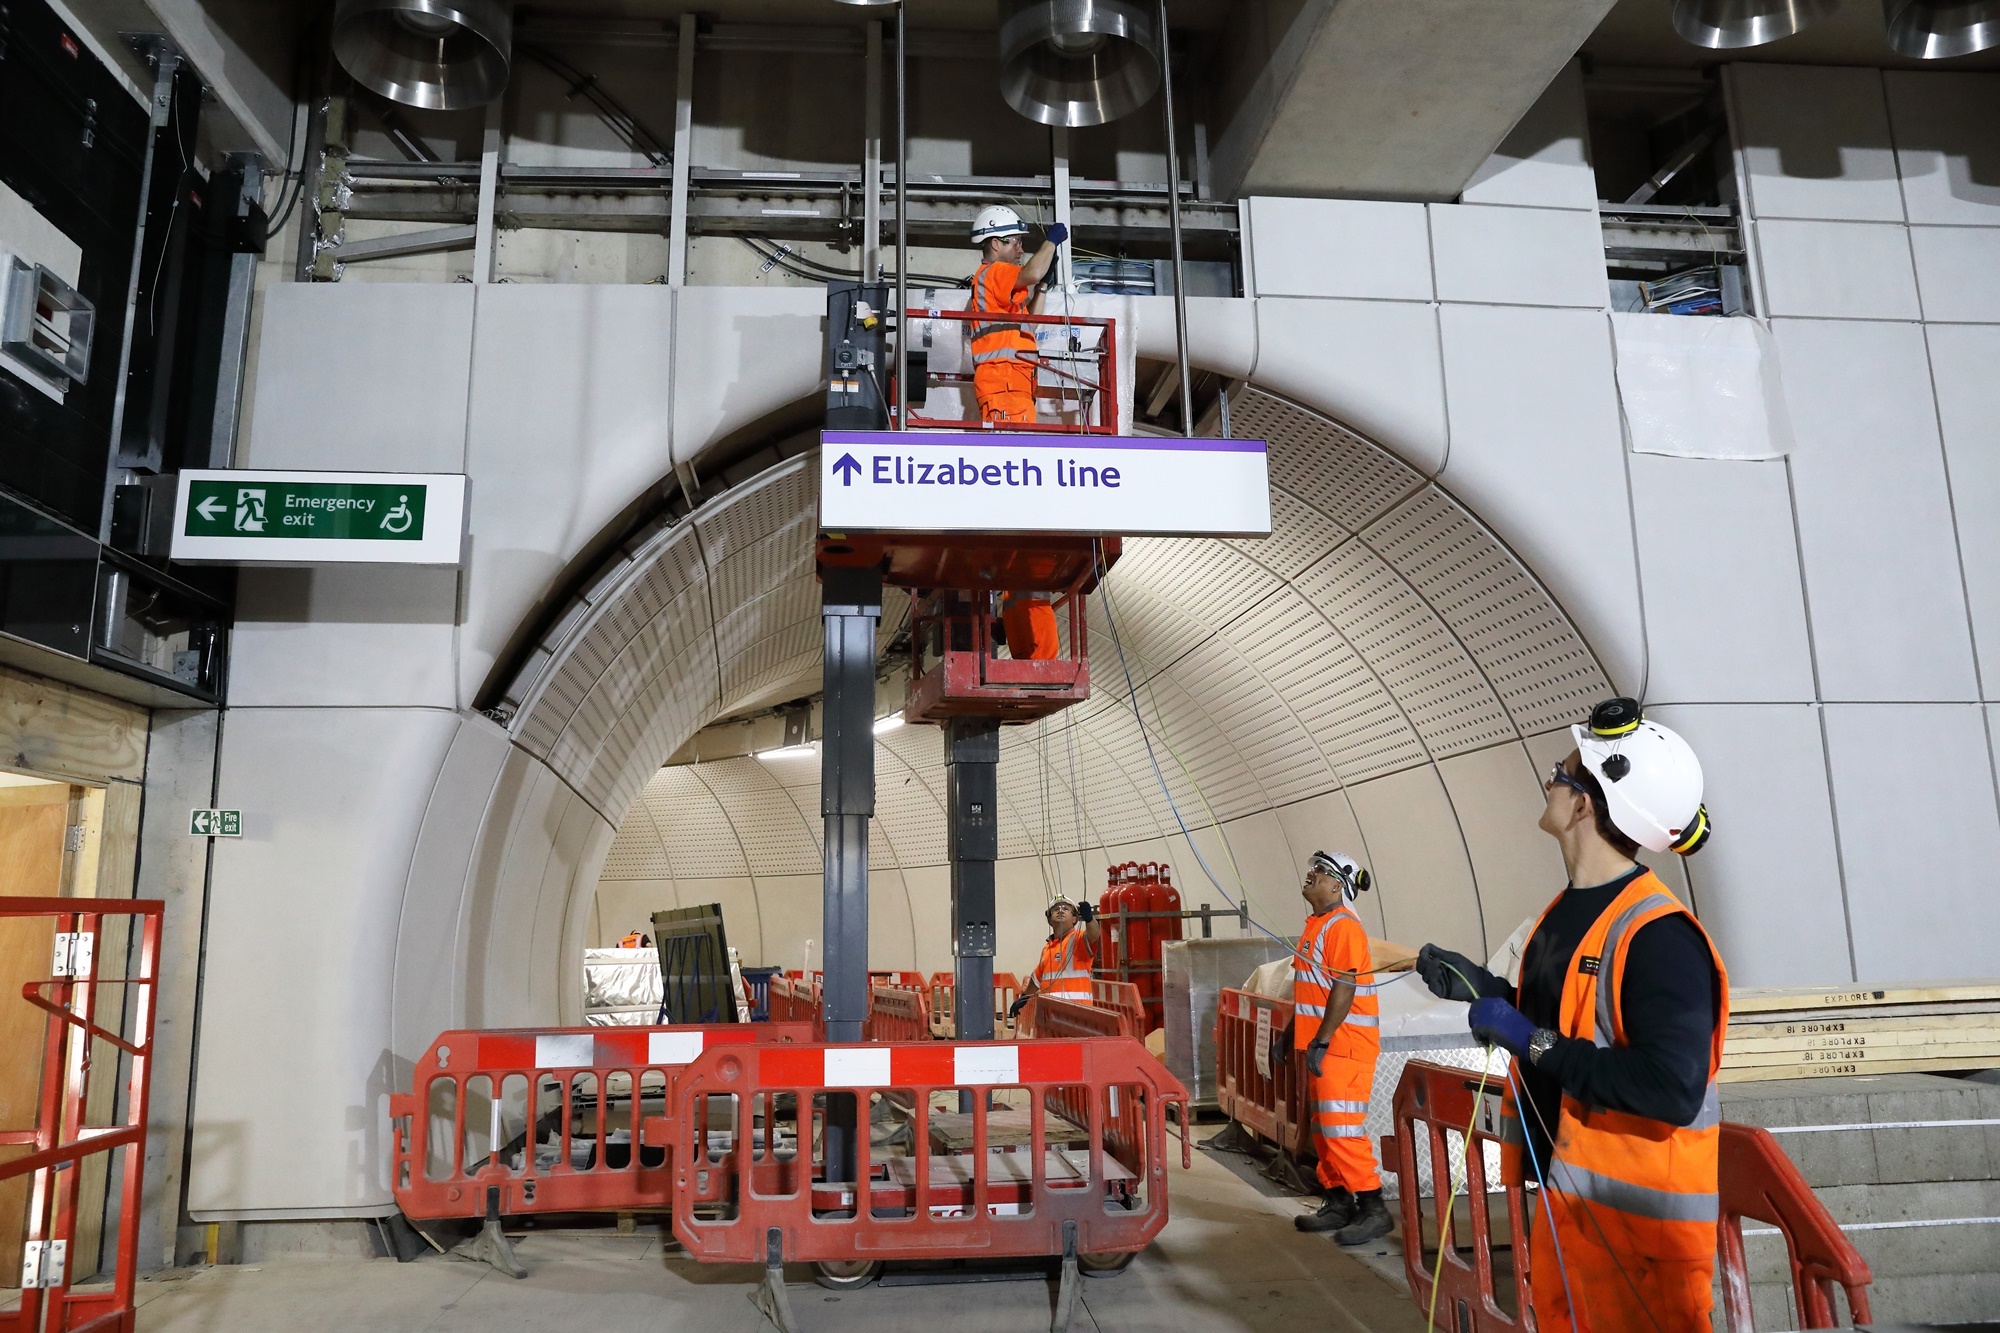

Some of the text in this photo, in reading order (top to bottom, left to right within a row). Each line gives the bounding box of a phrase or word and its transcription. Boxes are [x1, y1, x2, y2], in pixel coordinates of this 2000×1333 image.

[872, 455, 1121, 488] Elizabeth line
[285, 494, 376, 512] Emergency
[282, 512, 315, 526] exit
[224, 812, 237, 822] Fire
[224, 823, 237, 832] exit
[1824, 992, 1868, 1003] EXPLORE
[1786, 1023, 1845, 1034] EXPLORE 18
[1807, 1037, 1866, 1047] EXPLORE 18
[1819, 1050, 1865, 1060] EXPLORE
